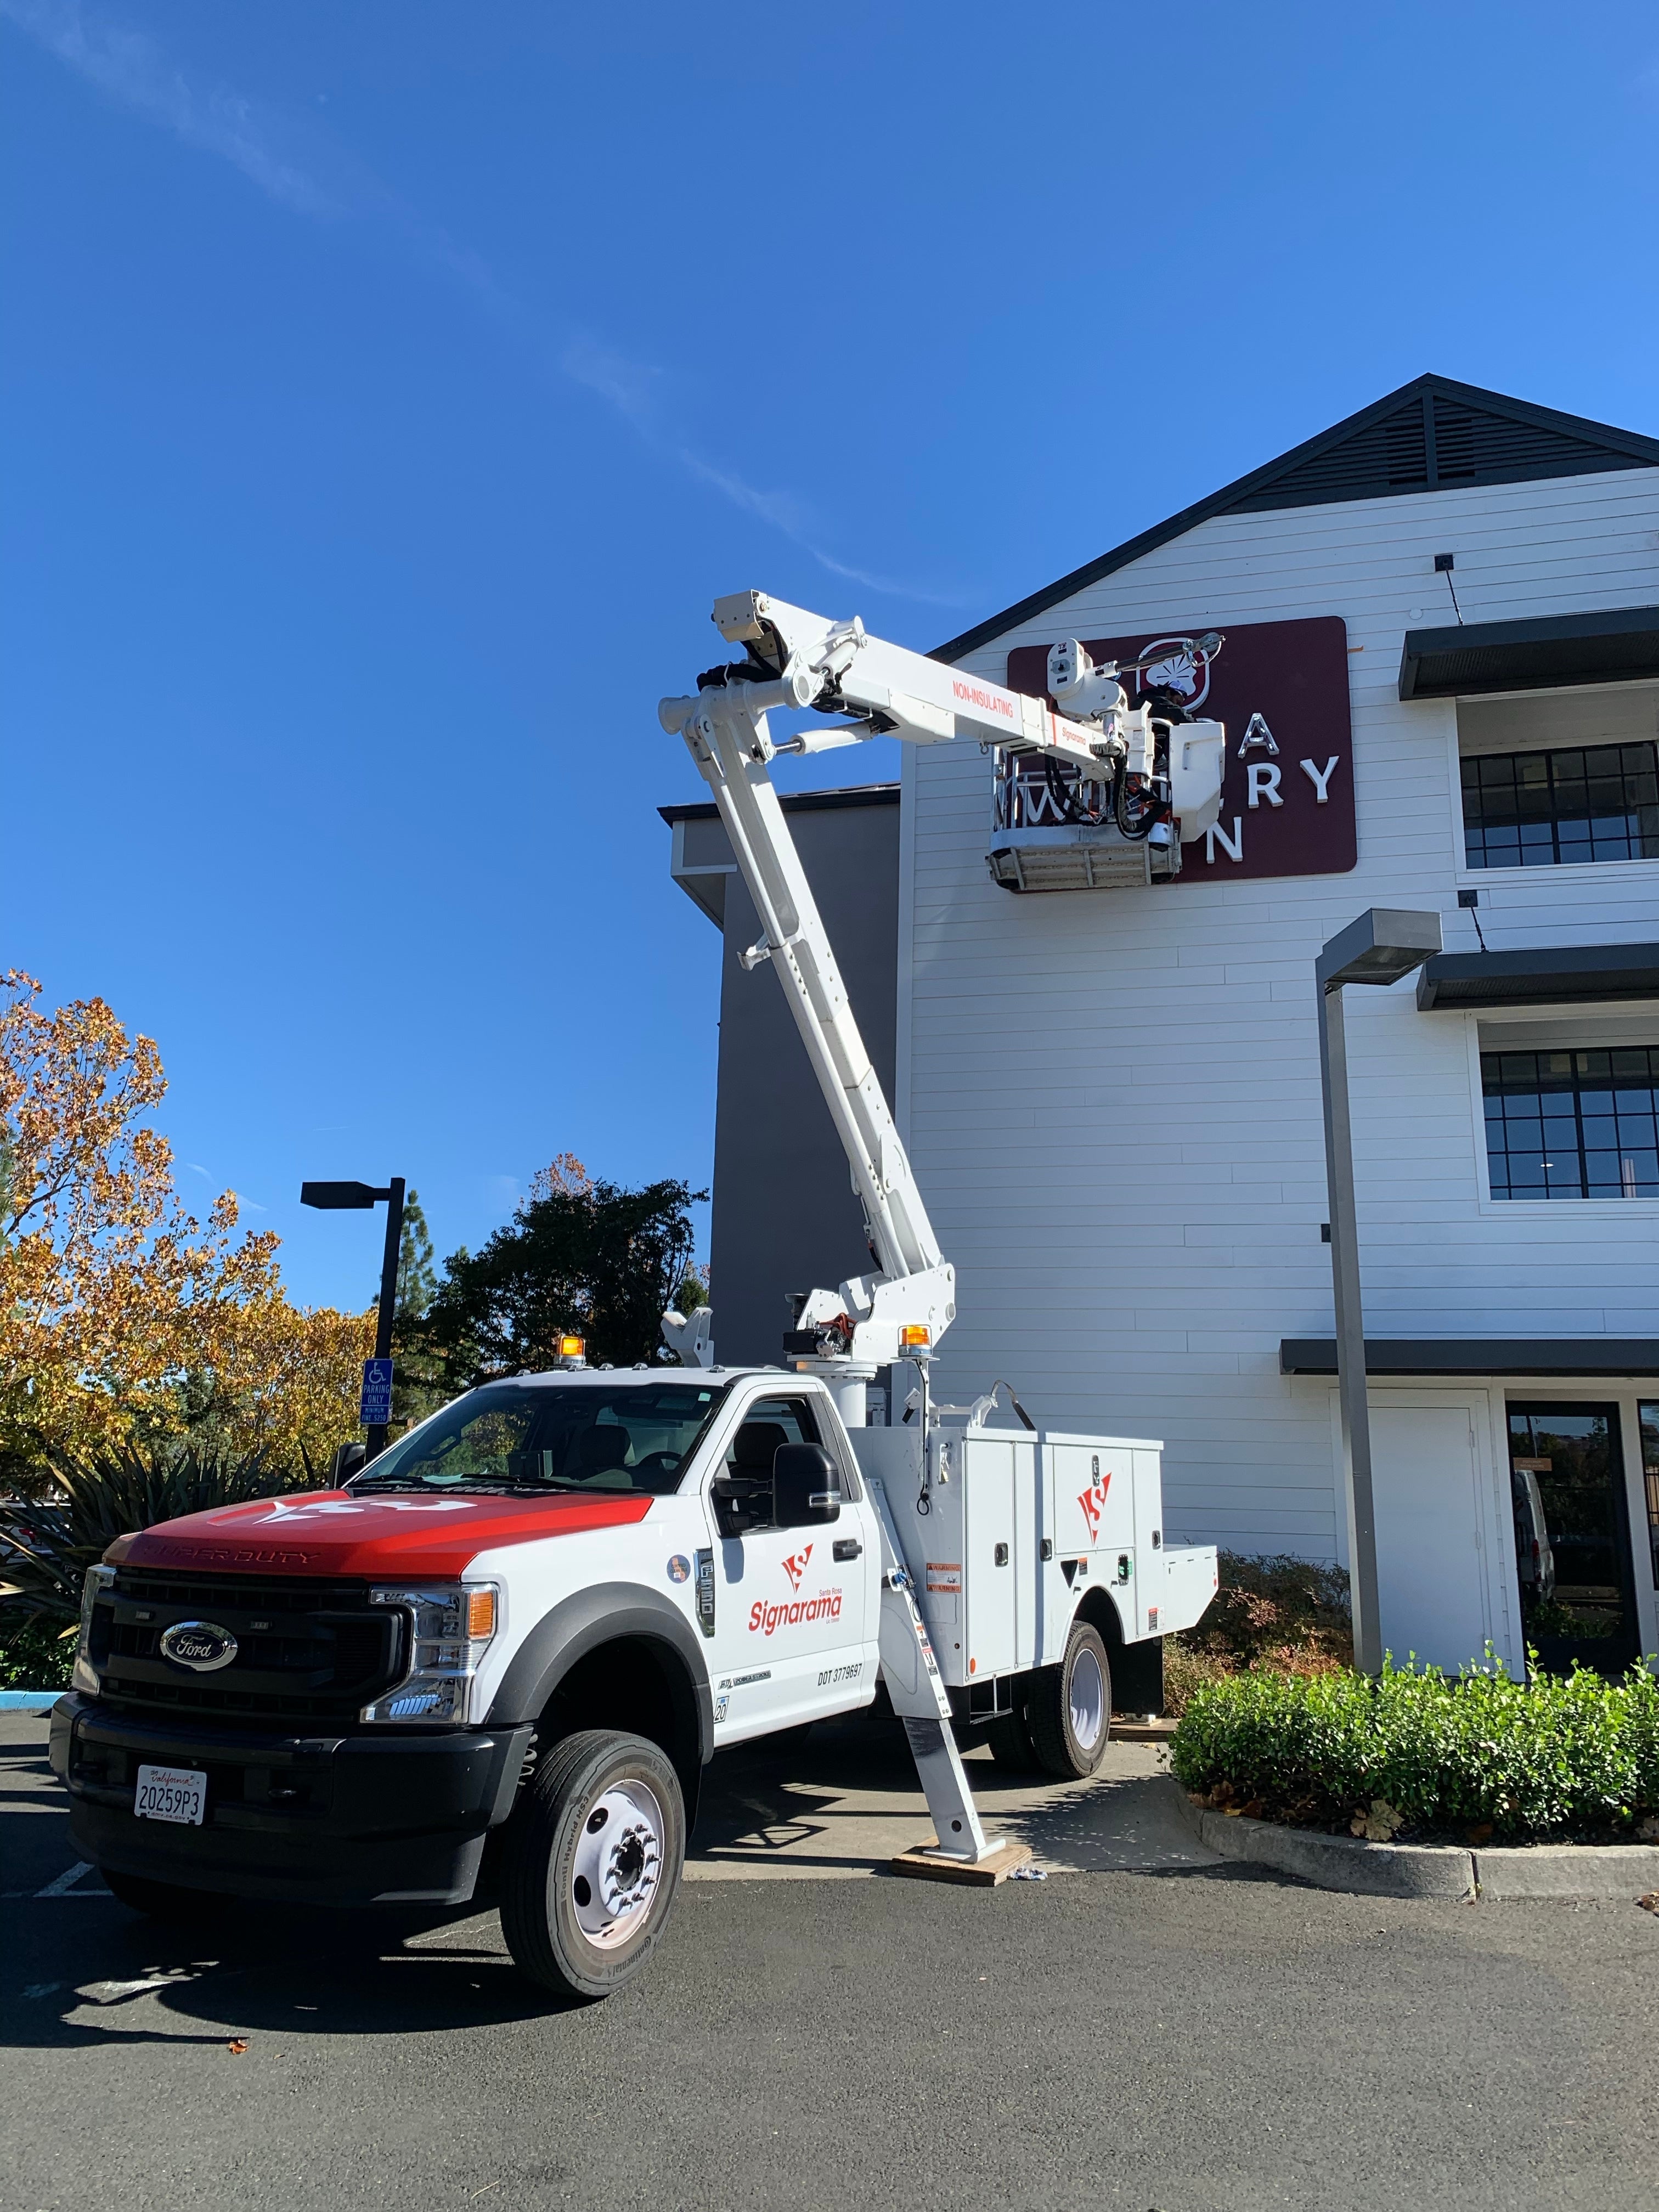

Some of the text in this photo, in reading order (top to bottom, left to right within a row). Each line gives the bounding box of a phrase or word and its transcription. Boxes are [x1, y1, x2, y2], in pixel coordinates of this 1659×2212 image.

[952, 680, 1014, 718] NON-INSULATING
[1062, 726, 1086, 746] Signarama
[363, 1384, 390, 1394] PARKING
[368, 1395, 384, 1404] ONLY
[234, 1548, 321, 1564] DUTY
[819, 1589, 831, 1597] Santa
[748, 1595, 842, 1637] Signarama
[176, 1634, 212, 1658] Ford
[735, 1675, 752, 1684] POWER
[752, 1671, 770, 1680] STROKE
[817, 1663, 862, 1686] DOT 3779697
[714, 1703, 726, 1722] 20
[151, 1772, 193, 1787] California
[139, 1785, 199, 1816] 20259P3
[151, 1812, 186, 1820] dmv.ca.gov
[563, 1819, 578, 1862] Hybrid
[576, 1796, 590, 1820] HS3
[612, 1936, 652, 1977] Continental
